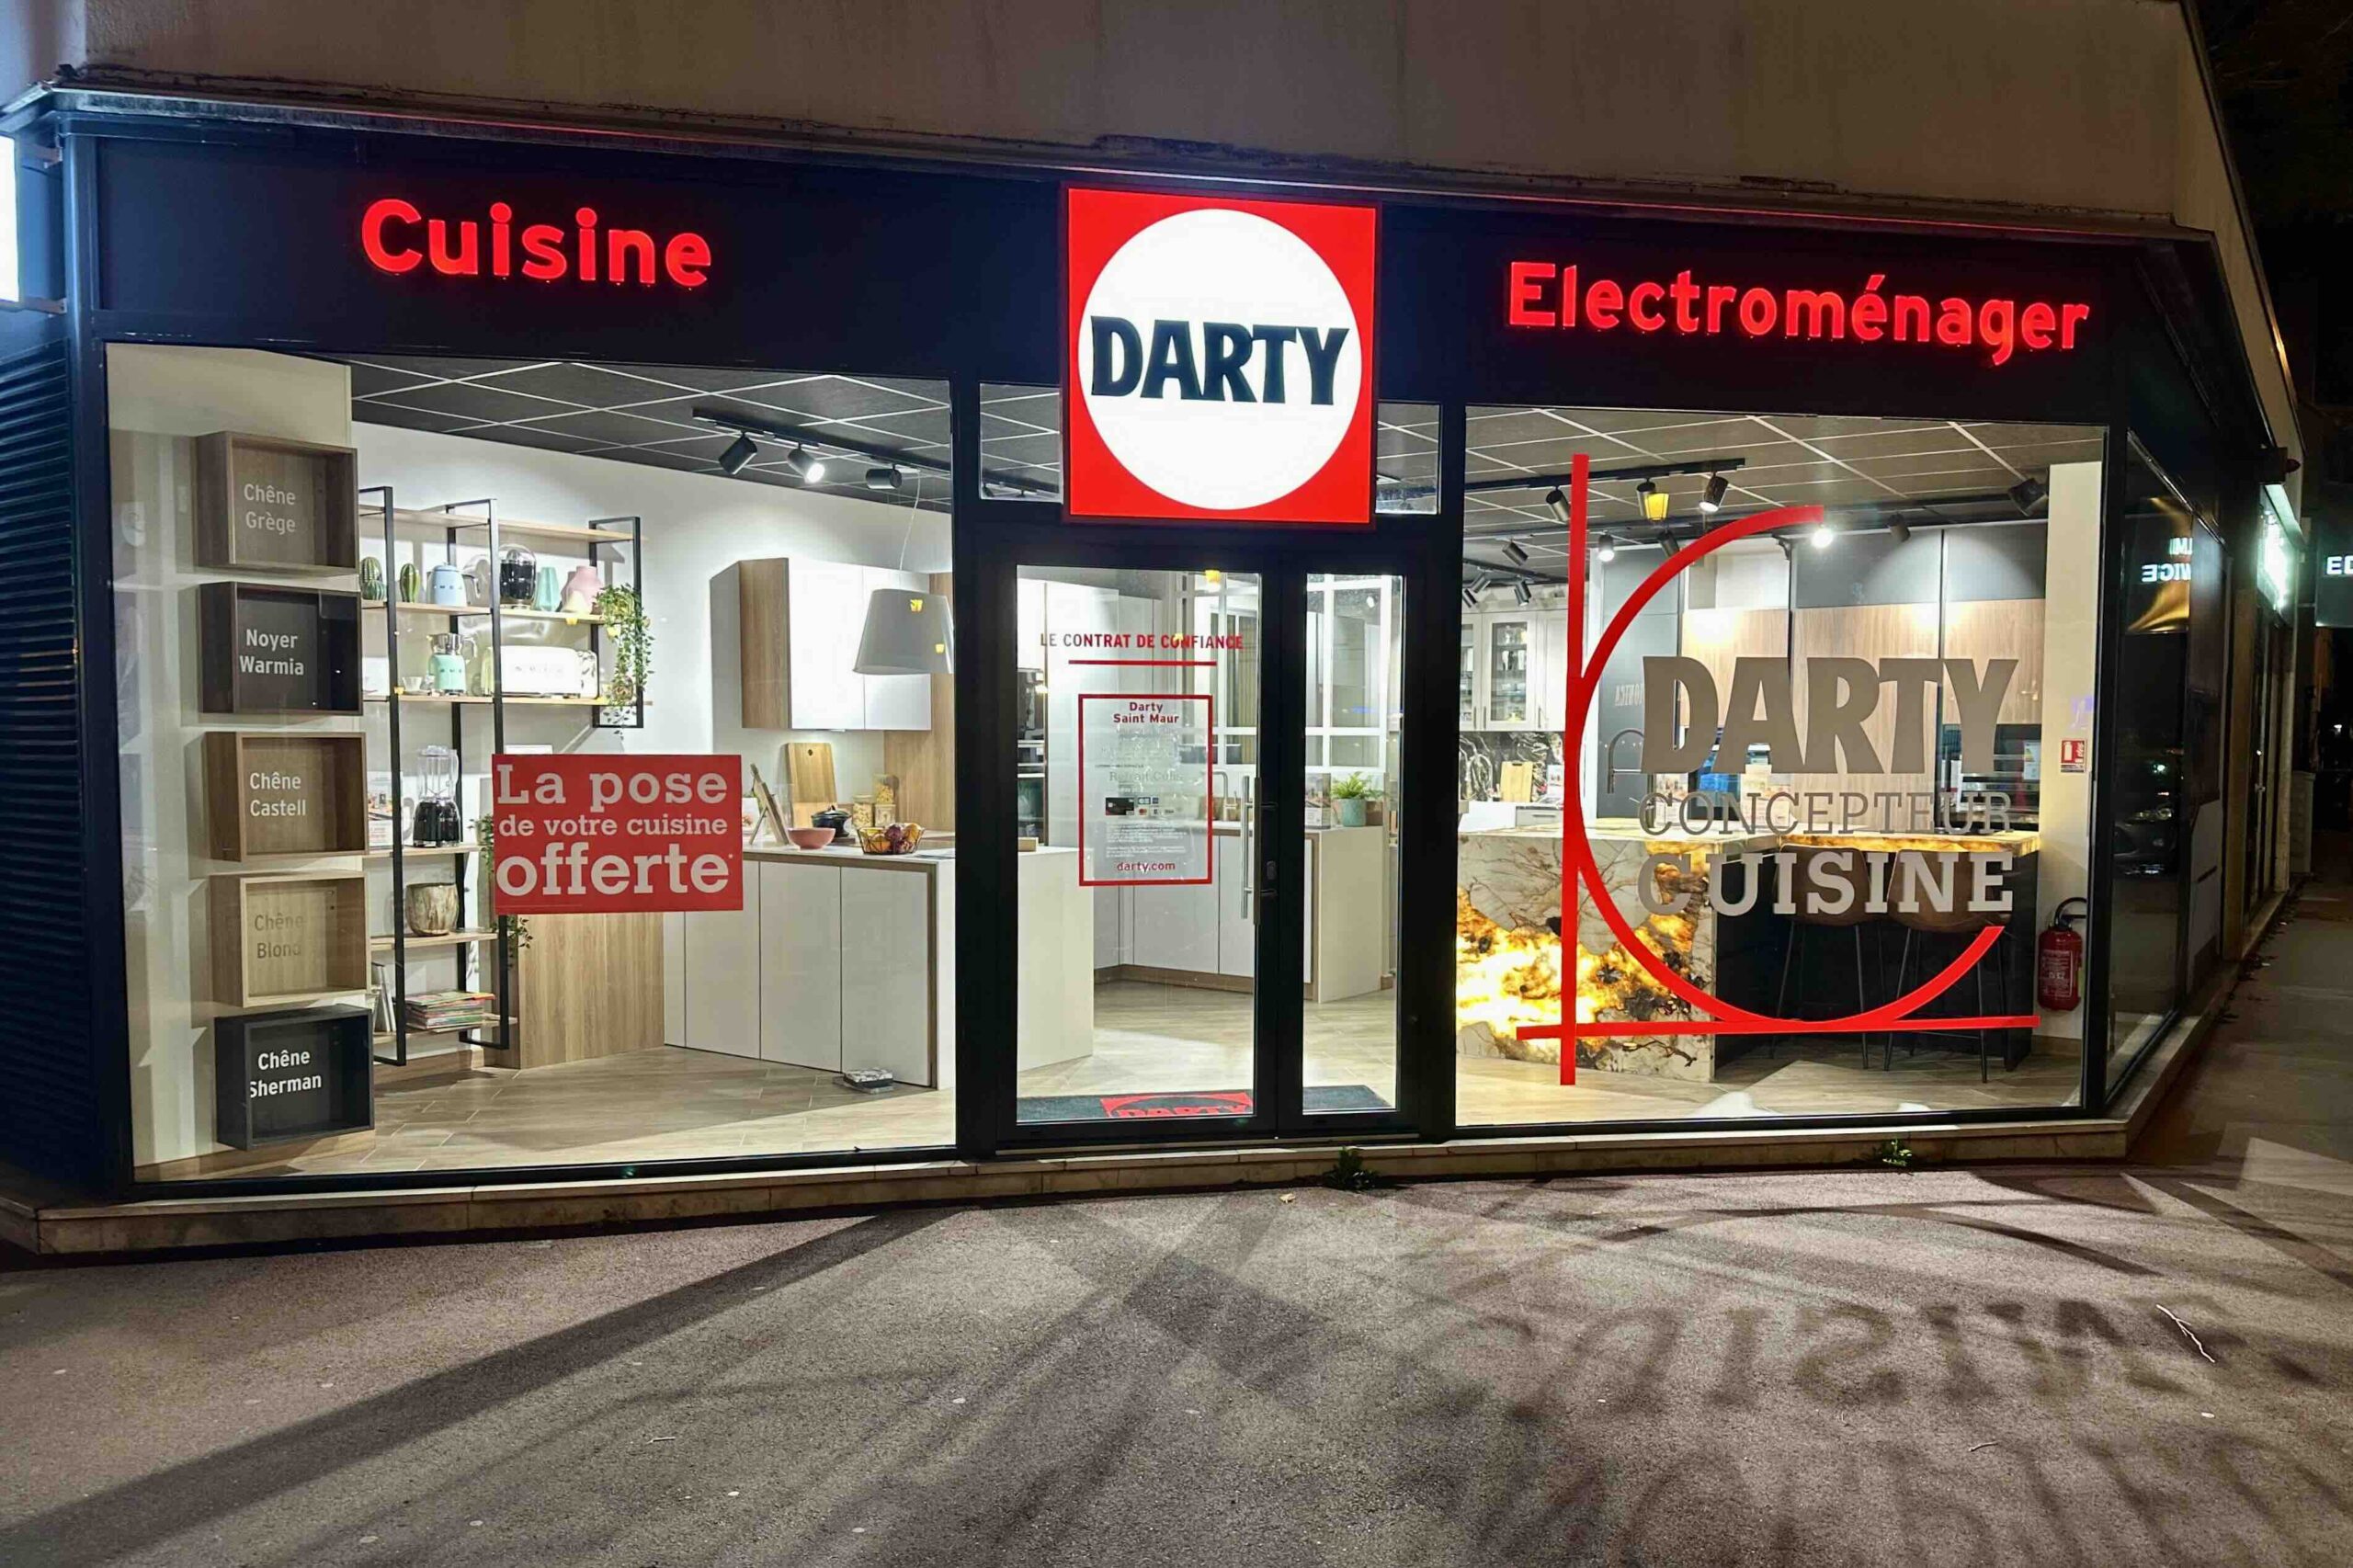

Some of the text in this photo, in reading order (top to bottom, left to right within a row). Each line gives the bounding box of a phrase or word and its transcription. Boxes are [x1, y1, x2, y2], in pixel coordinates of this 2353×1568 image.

[361, 199, 711, 287] Cuisine
[1509, 261, 2089, 365] Electroménager
[1090, 315, 1350, 405] DARTY
[244, 483, 296, 506] Chêne
[245, 512, 296, 535] Grège
[245, 629, 298, 652] Noyer
[1040, 633, 1244, 650] LE CONTRAT DE CONFIANCE
[239, 655, 304, 676] Warmia
[1113, 713, 1179, 723] Saint Maur
[1129, 701, 1164, 713] Darty
[1641, 655, 2019, 774] DARTY
[249, 771, 301, 790] Chêne
[496, 764, 727, 812] La pose
[250, 799, 306, 817] Castell
[1639, 791, 2014, 836] CONCEPTEUR
[498, 813, 728, 836] de votre cuisine
[1117, 861, 1176, 872] darty.com
[1638, 851, 2014, 916] CUISINE
[254, 913, 303, 931] Chêne
[257, 1049, 311, 1071] Chêne
[250, 1074, 322, 1098] Sherman
